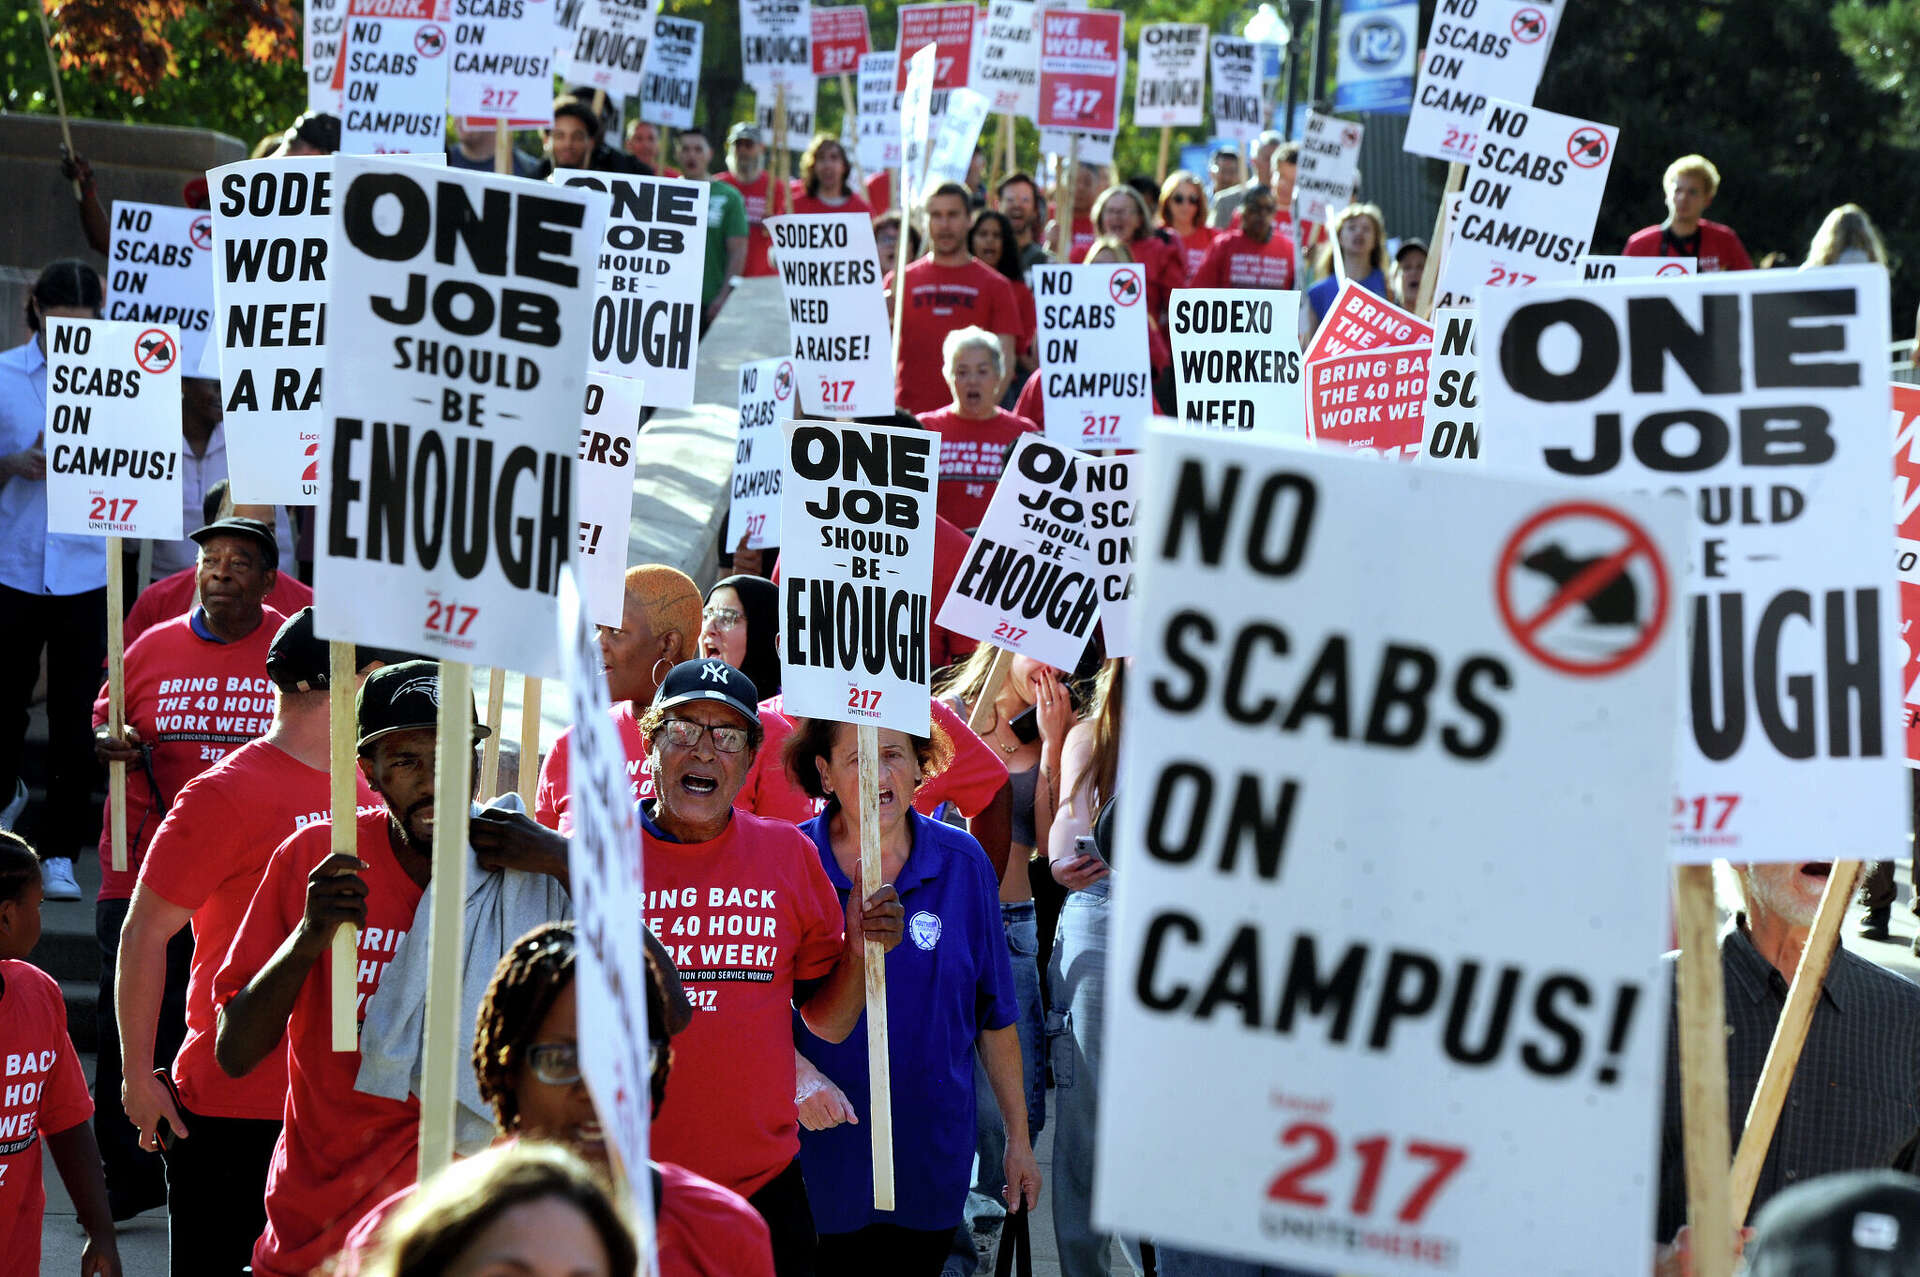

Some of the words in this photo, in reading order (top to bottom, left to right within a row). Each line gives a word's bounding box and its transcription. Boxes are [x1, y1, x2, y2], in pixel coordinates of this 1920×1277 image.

[455, 0, 524, 19] SCABS
[1443, 0, 1477, 19] NO
[352, 23, 382, 43] NO
[455, 24, 485, 45] ON
[655, 20, 697, 43] ONE
[990, 25, 1032, 41] SCABS
[1046, 17, 1079, 36] WE
[1146, 28, 1201, 44] ONE
[313, 43, 336, 59] ON
[574, 26, 647, 72] ENOUGH
[746, 36, 808, 63] ENOUGH
[1045, 37, 1112, 59] WORK.
[1215, 42, 1255, 60] ONE
[1435, 24, 1512, 59] SCABS
[350, 53, 418, 75] SCABS
[454, 53, 549, 77] CAMPUS!
[823, 46, 856, 69] 217
[1428, 54, 1463, 80] ON
[349, 82, 379, 102] ON
[482, 87, 518, 107] 217
[1053, 87, 1102, 112] 217
[1140, 79, 1200, 107] ENOUGH
[1213, 93, 1260, 124] ENOUGH
[347, 111, 441, 136] CAMPUS!
[1487, 107, 1529, 138] NO
[1304, 138, 1341, 156] SCABS
[1478, 143, 1568, 185] SCABS
[1469, 179, 1512, 210] ON
[116, 208, 152, 232] NO
[343, 172, 586, 288] ONE
[775, 223, 848, 248] SODEXO
[1460, 214, 1586, 265] CAMPUS!
[114, 239, 194, 268] SCABS
[112, 270, 148, 294] ON
[611, 275, 640, 293] BE
[783, 260, 876, 286] WORKERS
[1041, 271, 1072, 296] NO
[369, 273, 562, 348] JOB
[790, 298, 829, 324] NEED
[1043, 304, 1116, 330] SCABS
[1175, 300, 1273, 334] SODEXO
[1345, 295, 1413, 342] BRING
[53, 325, 92, 356] NO
[1335, 315, 1377, 348] THE
[795, 335, 805, 360] A
[807, 335, 871, 361] RAISE!
[1046, 339, 1078, 363] ON
[1500, 287, 1861, 404] ONE
[393, 336, 541, 390] SHOULD
[1181, 350, 1300, 384] WORKERS
[1318, 360, 1387, 385] BRING
[52, 364, 141, 398] SCABS
[225, 368, 259, 412] A
[741, 368, 757, 395] NO
[820, 381, 855, 403] 217
[1049, 373, 1147, 398] CAMPUS!
[441, 387, 486, 428] BE
[1319, 385, 1359, 407] THE
[1363, 382, 1389, 400] 40
[52, 404, 92, 435] ON
[739, 400, 775, 429] SCABS
[1082, 415, 1121, 436] 217
[1186, 399, 1256, 431] NEED
[1321, 405, 1384, 430] WORK
[737, 437, 754, 464] ON
[1348, 436, 1375, 448] Local
[1430, 421, 1480, 459] ON
[1544, 405, 1838, 477] JOB
[52, 444, 177, 481] CAMPUS!
[791, 426, 931, 492] ONE
[1086, 463, 1128, 493] NO
[89, 496, 138, 522] 217
[328, 416, 572, 597] ENOUGH
[805, 486, 920, 530] JOB
[1162, 460, 1319, 578] NO
[821, 526, 909, 557] SHOULD
[1037, 540, 1066, 561] BE
[852, 556, 880, 580] BE
[956, 538, 1099, 639] ENOUGH
[424, 599, 479, 636] 217
[787, 577, 927, 686] ENOUGH
[994, 622, 1028, 641] 217
[158, 677, 219, 695] BRING
[226, 677, 277, 695] BACK
[701, 662, 728, 685] NY
[1151, 609, 1514, 762] SCABS
[157, 696, 191, 713] THE
[194, 696, 219, 711] 40
[223, 697, 276, 714] HOUR
[848, 688, 882, 709] 217
[155, 715, 211, 732] WORK
[181, 733, 210, 741] EDUCATION
[211, 734, 226, 742] FOOD
[227, 735, 249, 743] SERVICE
[200, 748, 226, 761] 217
[1142, 761, 1300, 882] ON
[708, 887, 776, 909] BACK
[671, 915, 701, 937] 40
[708, 915, 777, 938] HOUR
[700, 944, 777, 967] WEEK!
[697, 971, 716, 980] FOOD
[718, 971, 745, 980] SERVICE
[747, 972, 773, 982] WORKERS
[685, 990, 718, 1007] 217
[1132, 910, 1642, 1086] CAMPUS!
[1265, 1120, 1469, 1224] 217
